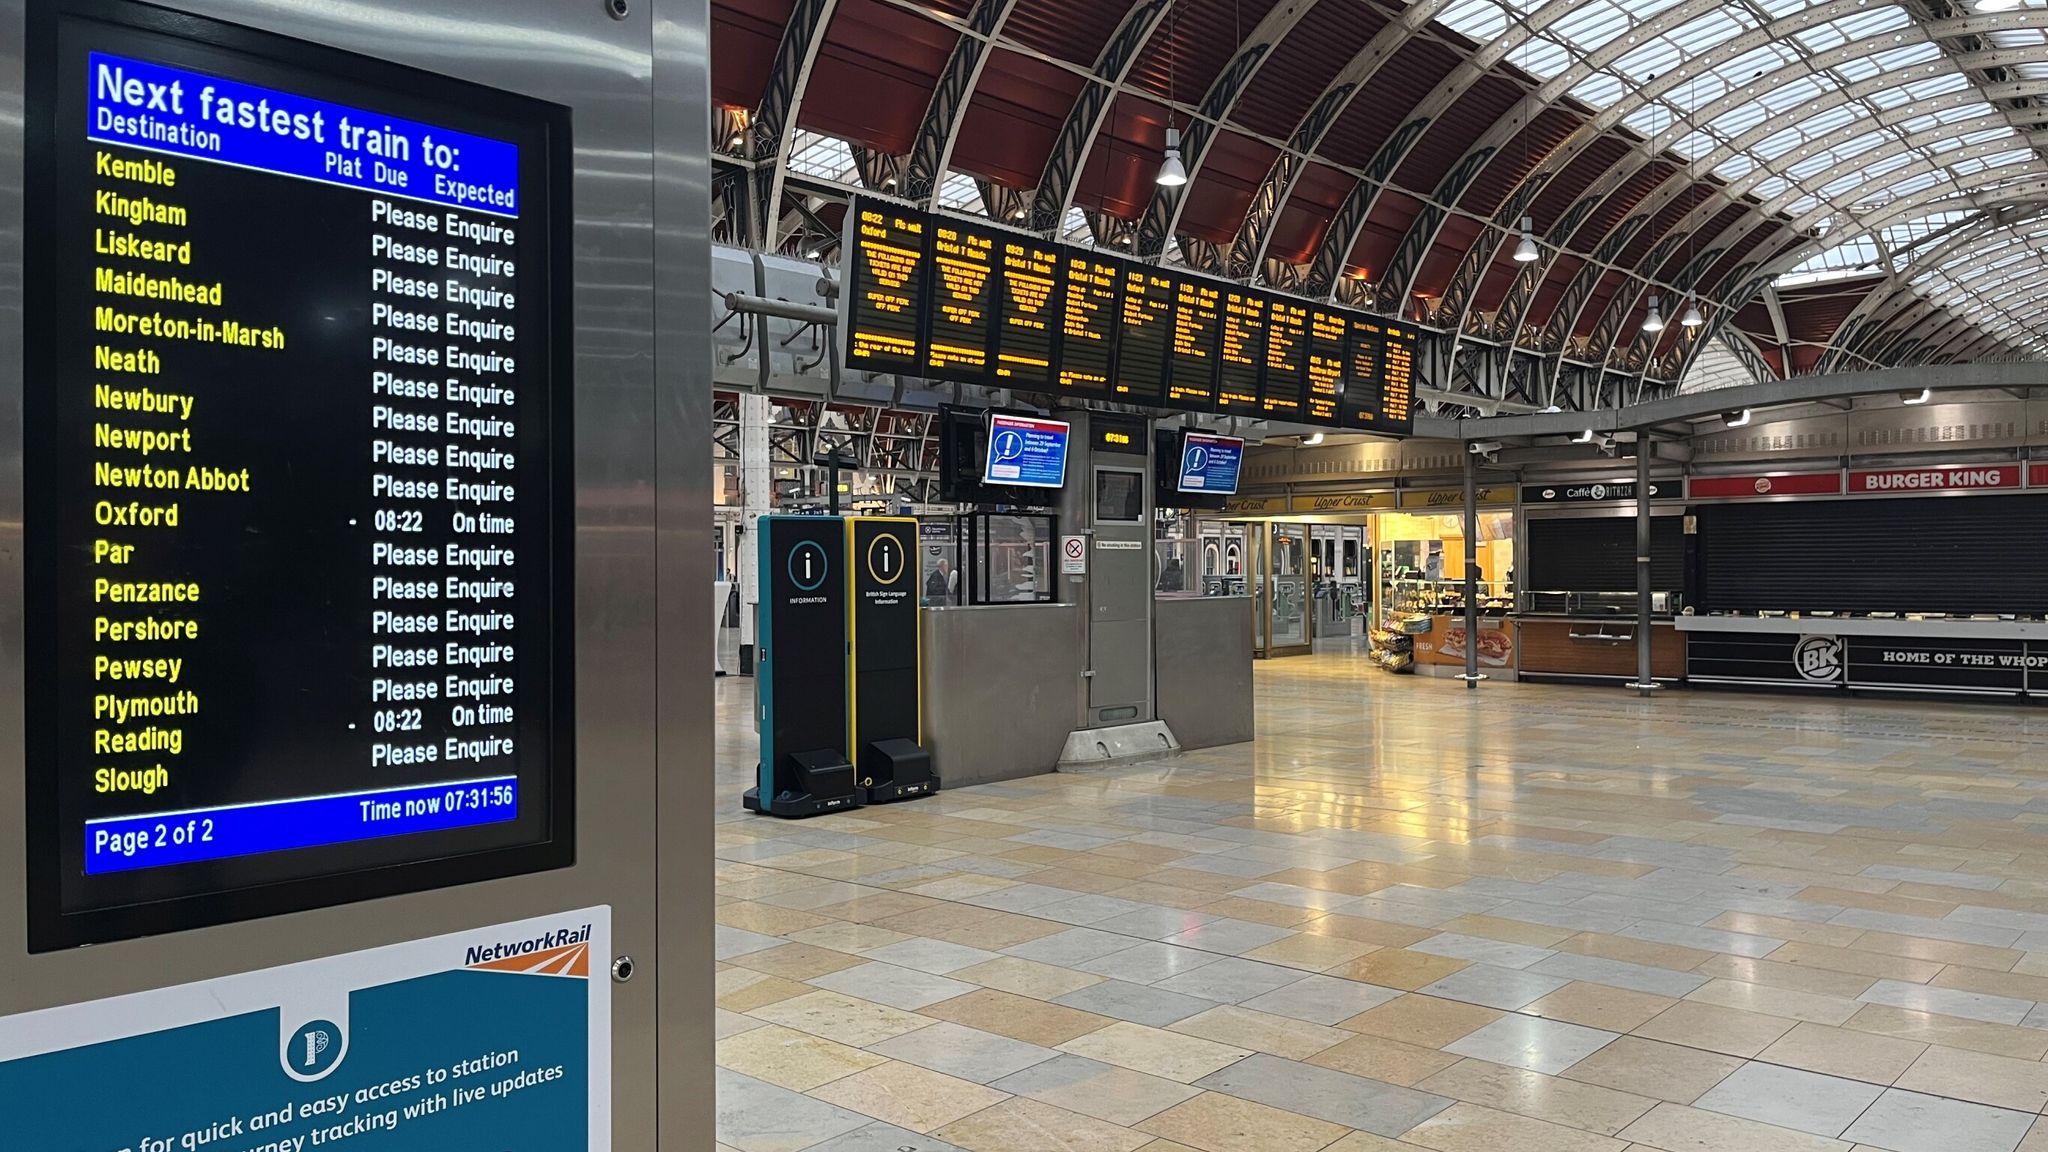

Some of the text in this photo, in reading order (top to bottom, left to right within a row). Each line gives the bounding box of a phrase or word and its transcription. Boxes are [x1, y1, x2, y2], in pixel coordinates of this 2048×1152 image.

[97, 107, 220, 152] Destination
[98, 64, 460, 172] Next fastest train to:
[96, 151, 176, 187] Kemble
[325, 152, 514, 208] Plat Due Expected
[96, 189, 187, 226] Kingham
[372, 199, 515, 246] Please Enquire
[861, 211, 883, 225] 08:22
[895, 219, 906, 230] Pls
[95, 228, 191, 265] Liskeard
[861, 225, 886, 238] Oxford
[372, 234, 515, 278] Please Enquire
[937, 241, 959, 254] Bristol
[961, 246, 966, 255] T
[1005, 256, 1026, 269] Bristol
[95, 266, 222, 306] Maidenhead
[372, 268, 515, 311] Please Enquire
[95, 306, 285, 350] Moreton-in-Marsh
[372, 302, 515, 343] Please Enquire
[95, 345, 160, 375] Neath
[372, 337, 515, 376] Please Enquire
[95, 383, 194, 421] Newbury
[372, 371, 515, 408] Please Enquire
[373, 405, 515, 441] Please Enquire
[95, 422, 192, 456] Newport
[373, 440, 515, 473] Please Enquire
[95, 462, 250, 492] Newton Abbot
[373, 474, 515, 506] Please Enquire
[1866, 470, 2001, 489] BURGER KING
[1240, 500, 1268, 510] Crust
[1314, 495, 1373, 510] Upper Crust
[1427, 489, 1492, 506] Upper Cst
[1566, 487, 1590, 498] Caffè
[95, 500, 178, 527] Oxford
[374, 509, 515, 534] 08:22 On time
[94, 539, 135, 564] Par
[373, 542, 515, 571] Please Enquire
[95, 578, 200, 603] Penzance
[372, 576, 515, 604] Please Enquire
[95, 616, 198, 642] Pershore
[372, 609, 514, 636] Please Enquire
[372, 641, 514, 669] Please Enquire
[1416, 642, 1433, 650] FRESH
[1803, 645, 1838, 673] BK
[1883, 652, 1930, 663] HOME
[1934, 653, 1955, 664] OF
[1960, 654, 1995, 665] THE
[95, 655, 182, 683] Pewsey
[372, 673, 514, 702] Please Enquire
[95, 690, 199, 724] Plymouth
[373, 703, 514, 733] 08:22 On time
[95, 726, 182, 755] Reading
[372, 734, 514, 767] Please Enquire
[95, 763, 169, 795] Slough
[359, 785, 513, 823] Time now 07:31:56
[95, 818, 213, 857] Page 2 of 2
[181, 1116, 243, 1152] quick
[249, 1102, 292, 1131] and
[299, 1093, 350, 1118] easy
[355, 1075, 421, 1104] access
[425, 1068, 447, 1085] to
[452, 1050, 519, 1079] station
[310, 1110, 398, 1146] tracking
[403, 1093, 447, 1120] with
[453, 1086, 486, 1107] live
[491, 1065, 563, 1098] updates
